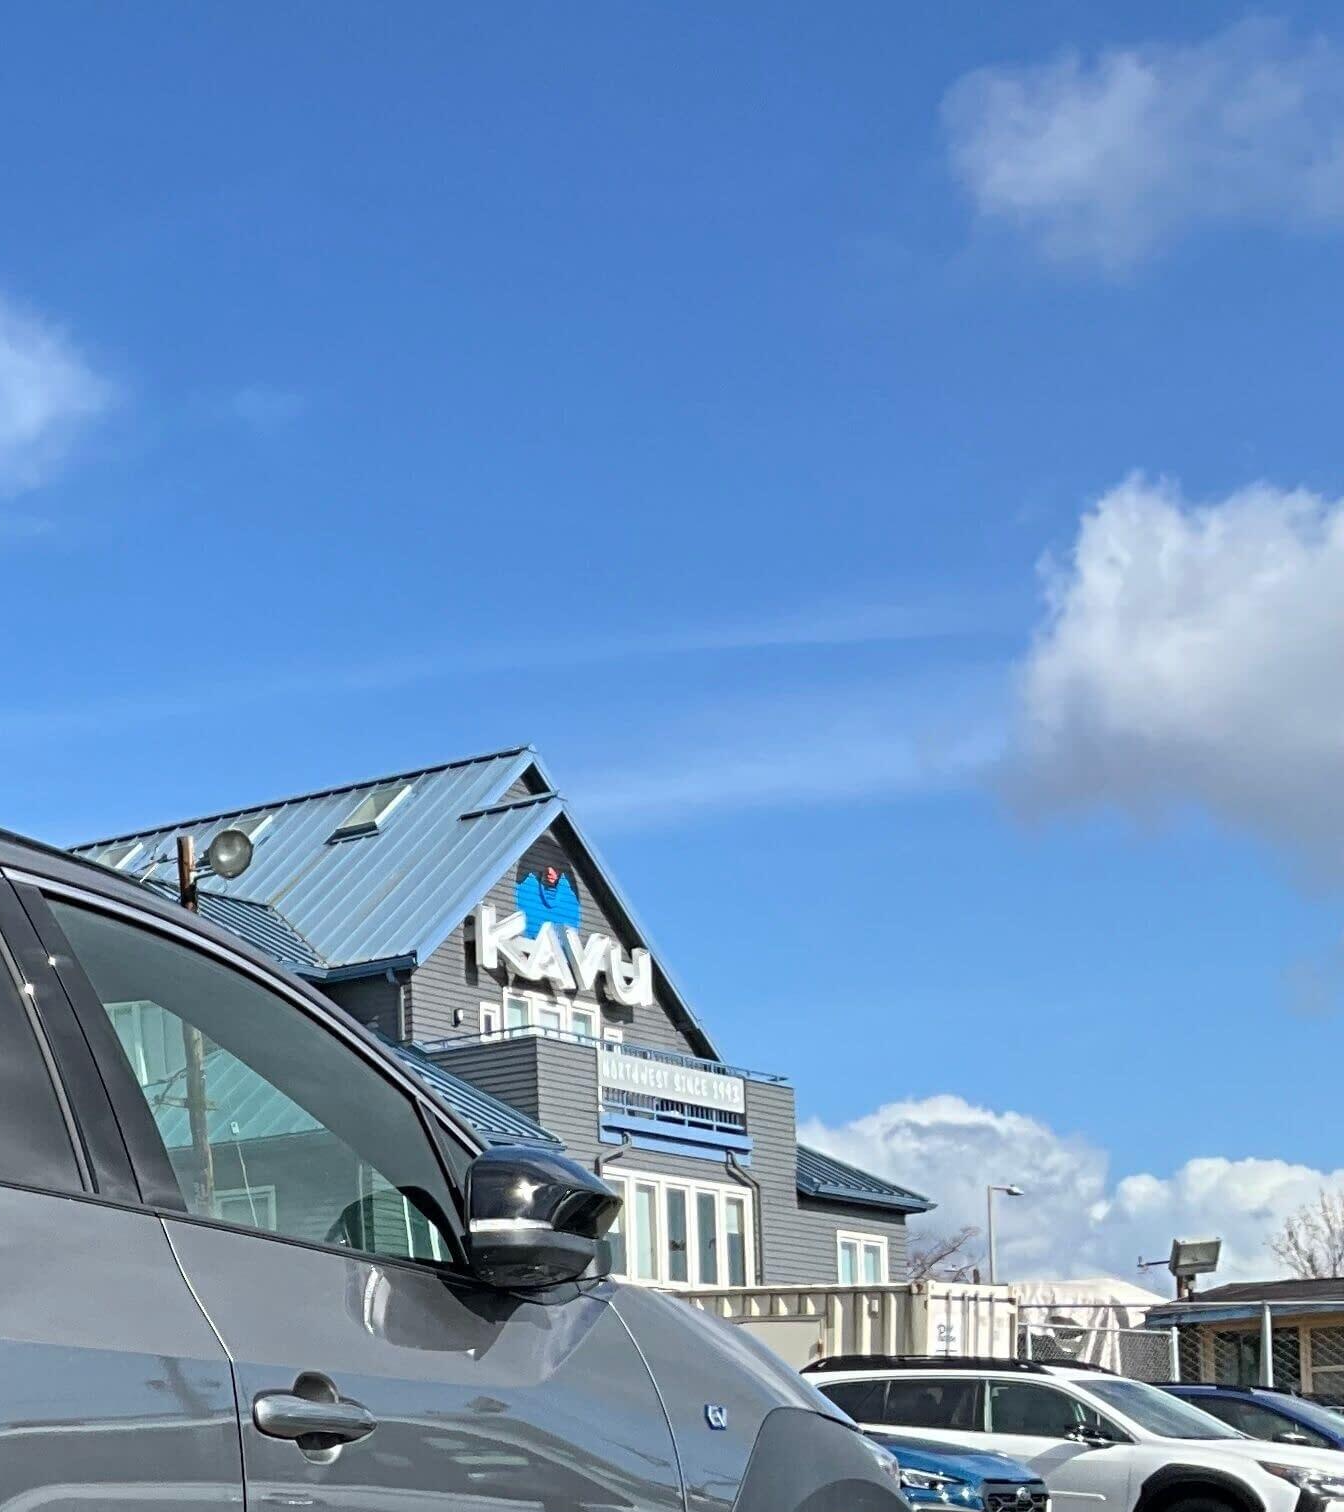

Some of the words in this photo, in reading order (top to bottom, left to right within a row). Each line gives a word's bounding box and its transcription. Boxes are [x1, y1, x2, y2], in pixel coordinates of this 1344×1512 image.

[476, 903, 653, 1007] KAVU
[603, 1055, 669, 1089] NORTHWEST
[674, 1071, 708, 1097] SINCE
